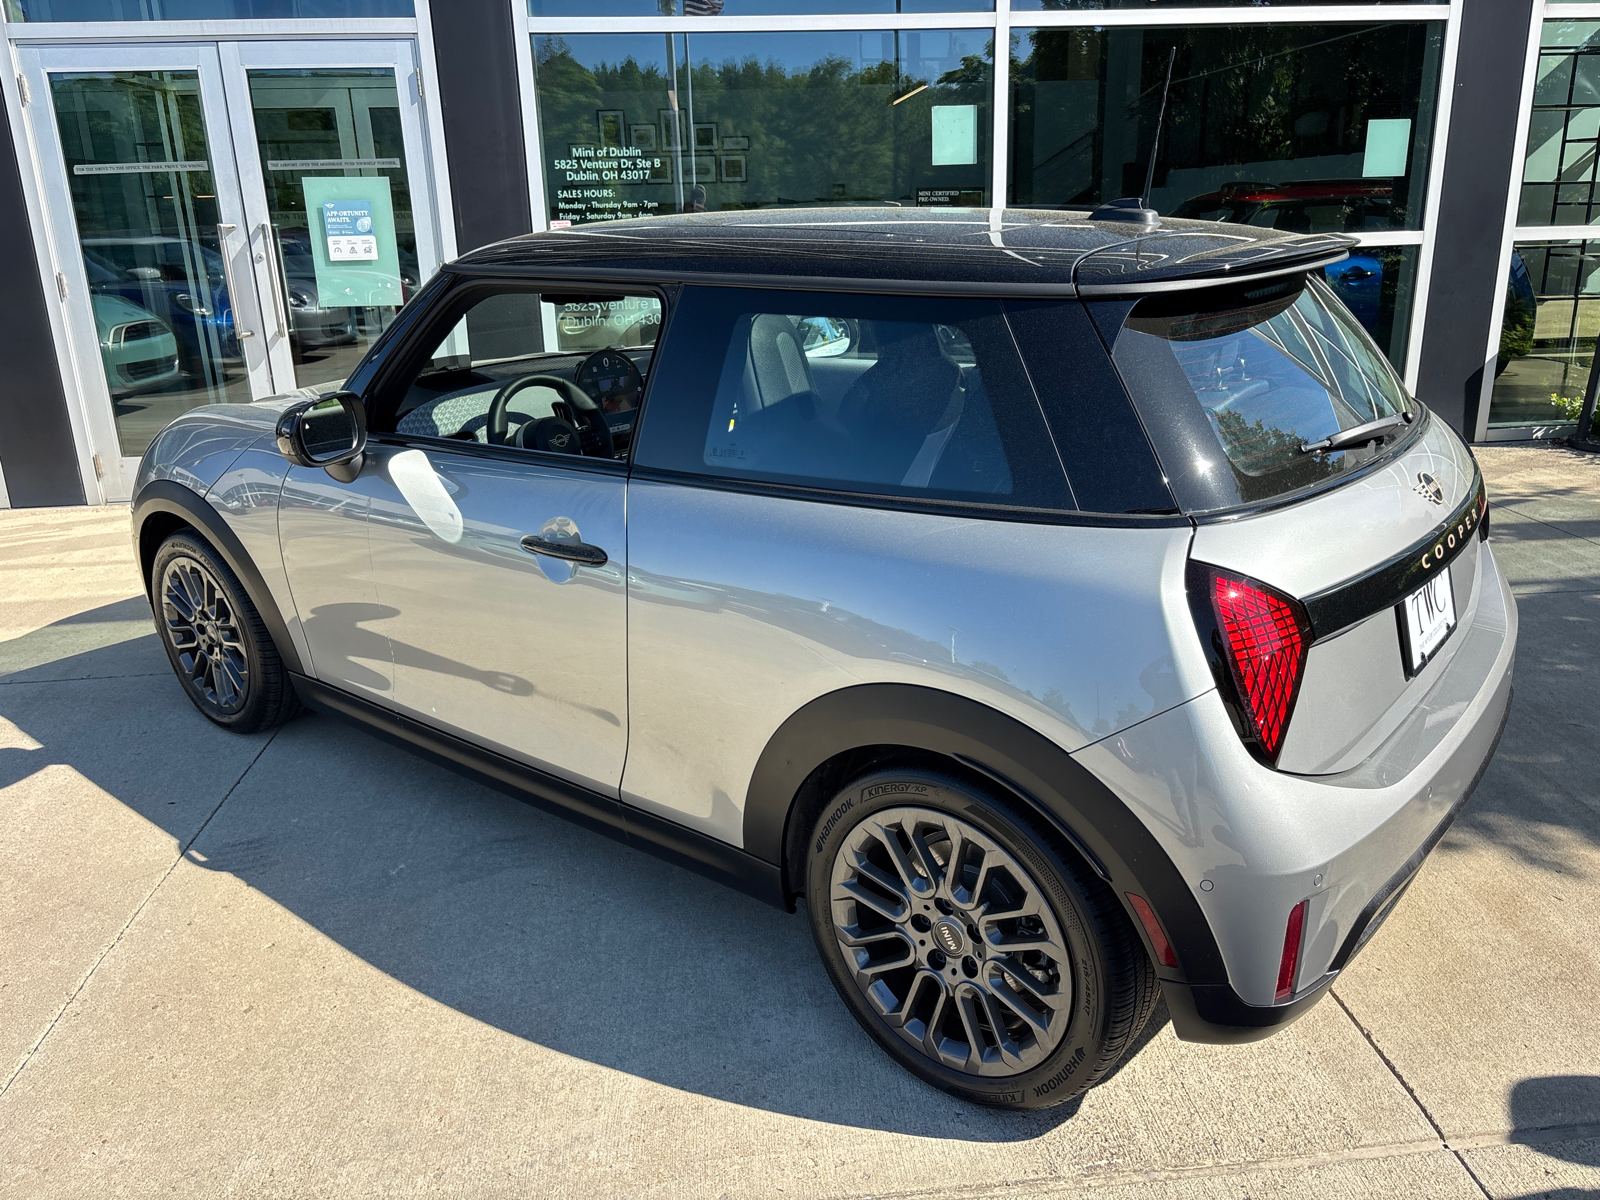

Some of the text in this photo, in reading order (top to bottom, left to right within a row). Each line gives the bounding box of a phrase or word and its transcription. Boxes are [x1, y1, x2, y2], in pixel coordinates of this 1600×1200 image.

[572, 147, 642, 157] Mini of Dublin
[554, 158, 661, 169] 5825 Venture Dr, Ste B
[602, 171, 618, 180] OH
[620, 170, 650, 180] 43017
[557, 189, 616, 198] SALES HOURS:
[558, 201, 586, 210] Monday
[591, 201, 621, 209] Thursday
[622, 200, 638, 208] 9am
[643, 200, 659, 209] 7pm
[559, 213, 580, 221] Friday
[586, 212, 616, 220] Saturday
[617, 211, 633, 219] 9am
[565, 302, 596, 311] 5825
[600, 300, 649, 310] Venture
[614, 314, 635, 326] OH
[1421, 508, 1477, 569] COOPER
[941, 926, 957, 950] MINI
